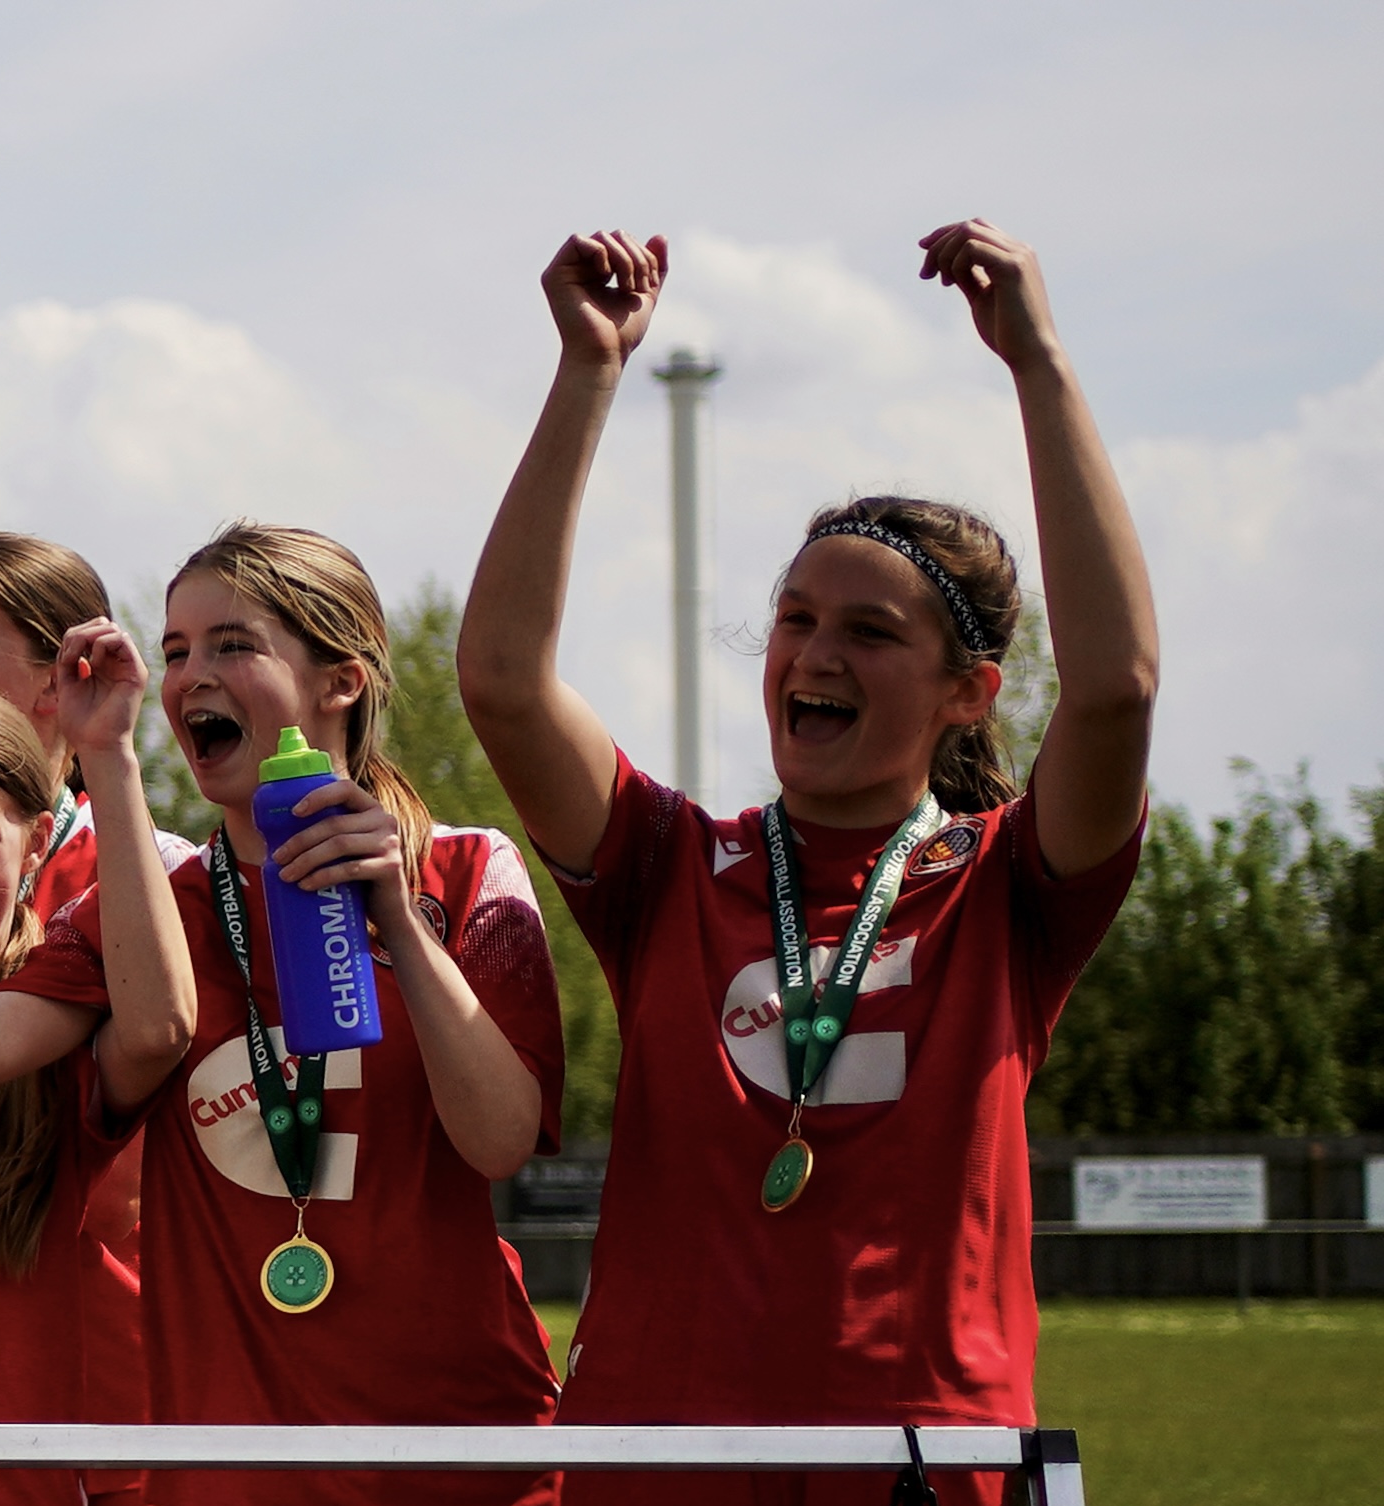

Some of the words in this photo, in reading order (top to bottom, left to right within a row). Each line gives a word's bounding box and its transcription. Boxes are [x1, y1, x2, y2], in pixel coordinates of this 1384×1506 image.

[769, 836, 792, 900] FOOTBALL
[871, 833, 919, 899] FOOTBALL
[220, 871, 248, 947] FOOTBALL
[776, 901, 804, 988] ASSOCIATION
[835, 896, 888, 987] ASSOCIATION
